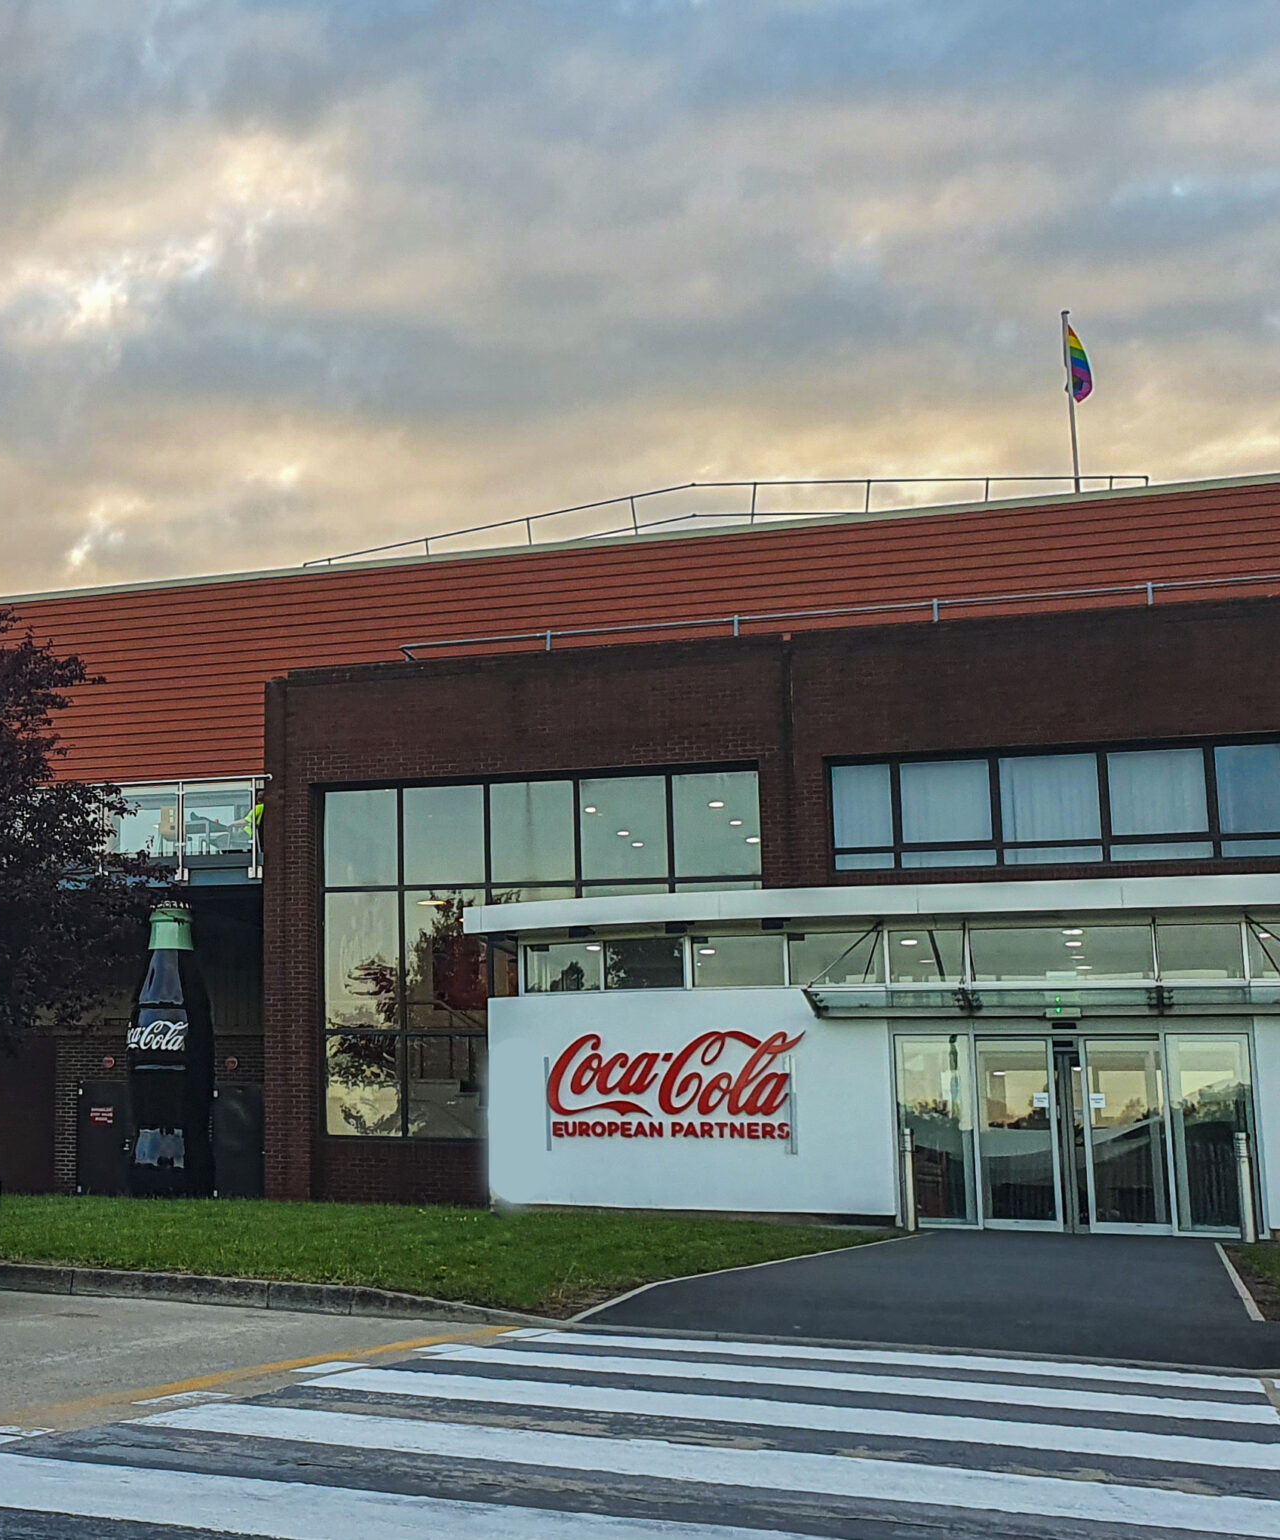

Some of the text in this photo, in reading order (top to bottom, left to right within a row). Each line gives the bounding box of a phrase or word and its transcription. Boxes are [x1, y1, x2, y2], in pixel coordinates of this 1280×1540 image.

[546, 1030, 806, 1117] Coca-Cola
[552, 1121, 790, 1140] EUROPEAN PARTNERS
